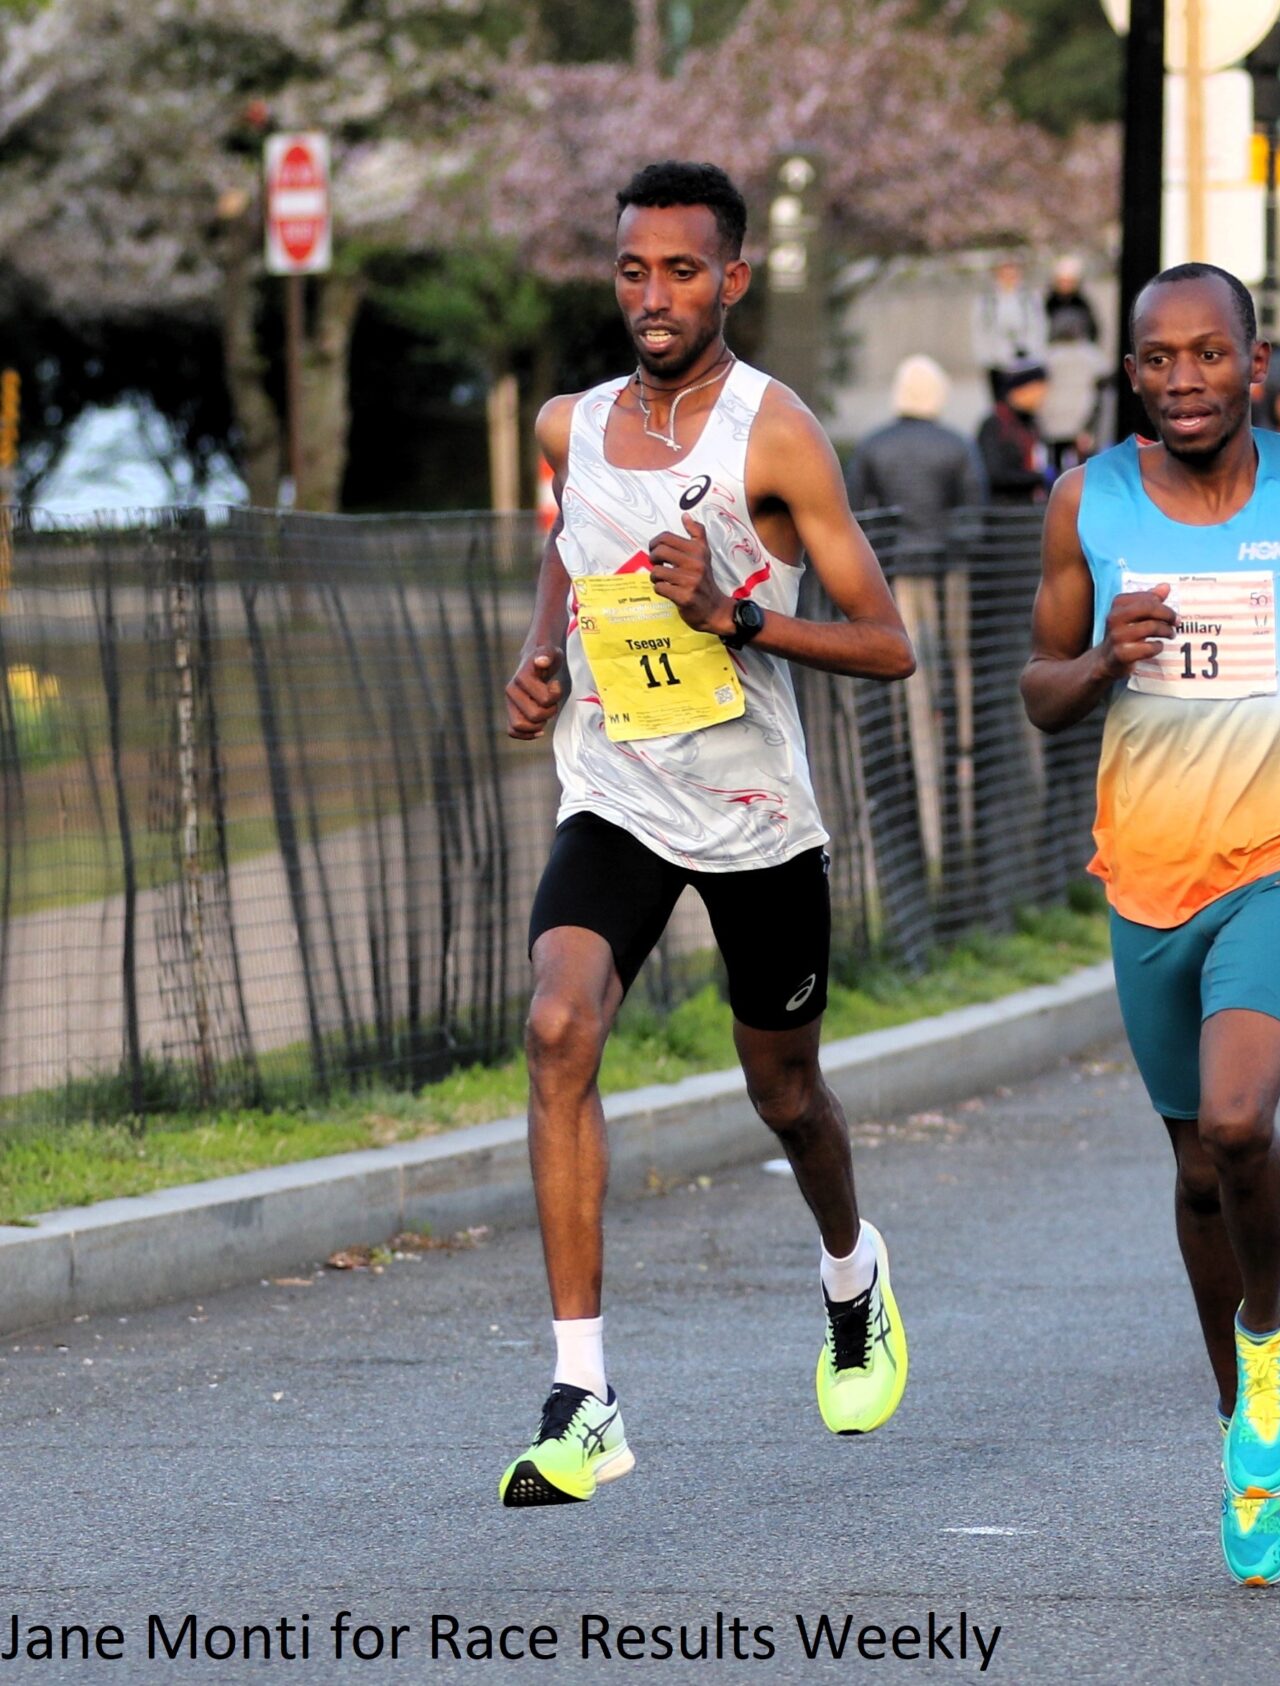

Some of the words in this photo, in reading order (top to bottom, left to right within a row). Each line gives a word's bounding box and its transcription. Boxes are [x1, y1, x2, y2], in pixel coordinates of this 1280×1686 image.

[1176, 622, 1222, 636] Hillary
[625, 637, 672, 651] Tsegay
[640, 652, 681, 689] 11
[1180, 641, 1219, 680] 13
